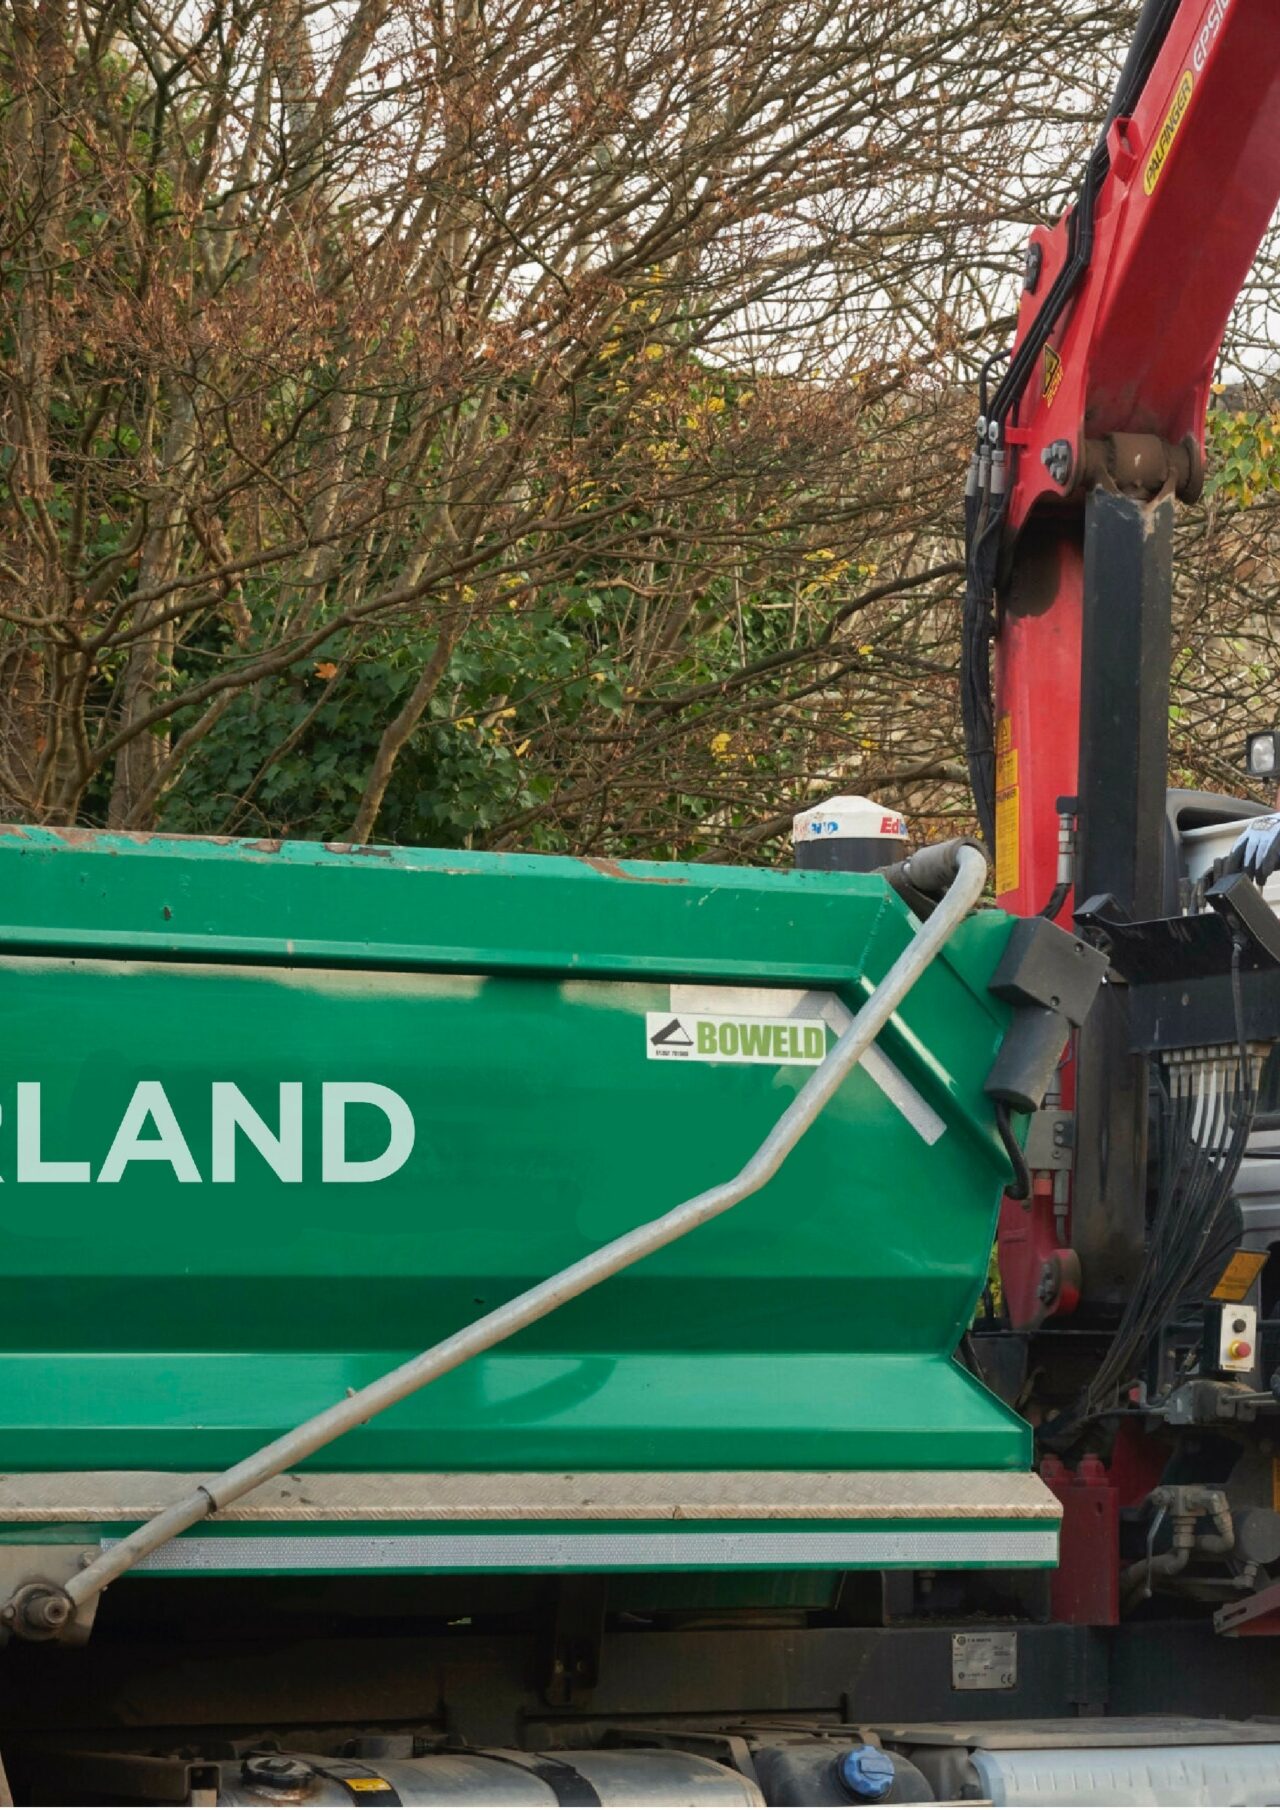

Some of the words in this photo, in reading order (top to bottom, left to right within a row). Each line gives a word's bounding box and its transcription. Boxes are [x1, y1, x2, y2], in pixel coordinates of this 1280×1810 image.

[1146, 79, 1192, 189] PALFINGER
[696, 1021, 824, 1059] BOWELD
[0, 1081, 416, 1183] LAND
